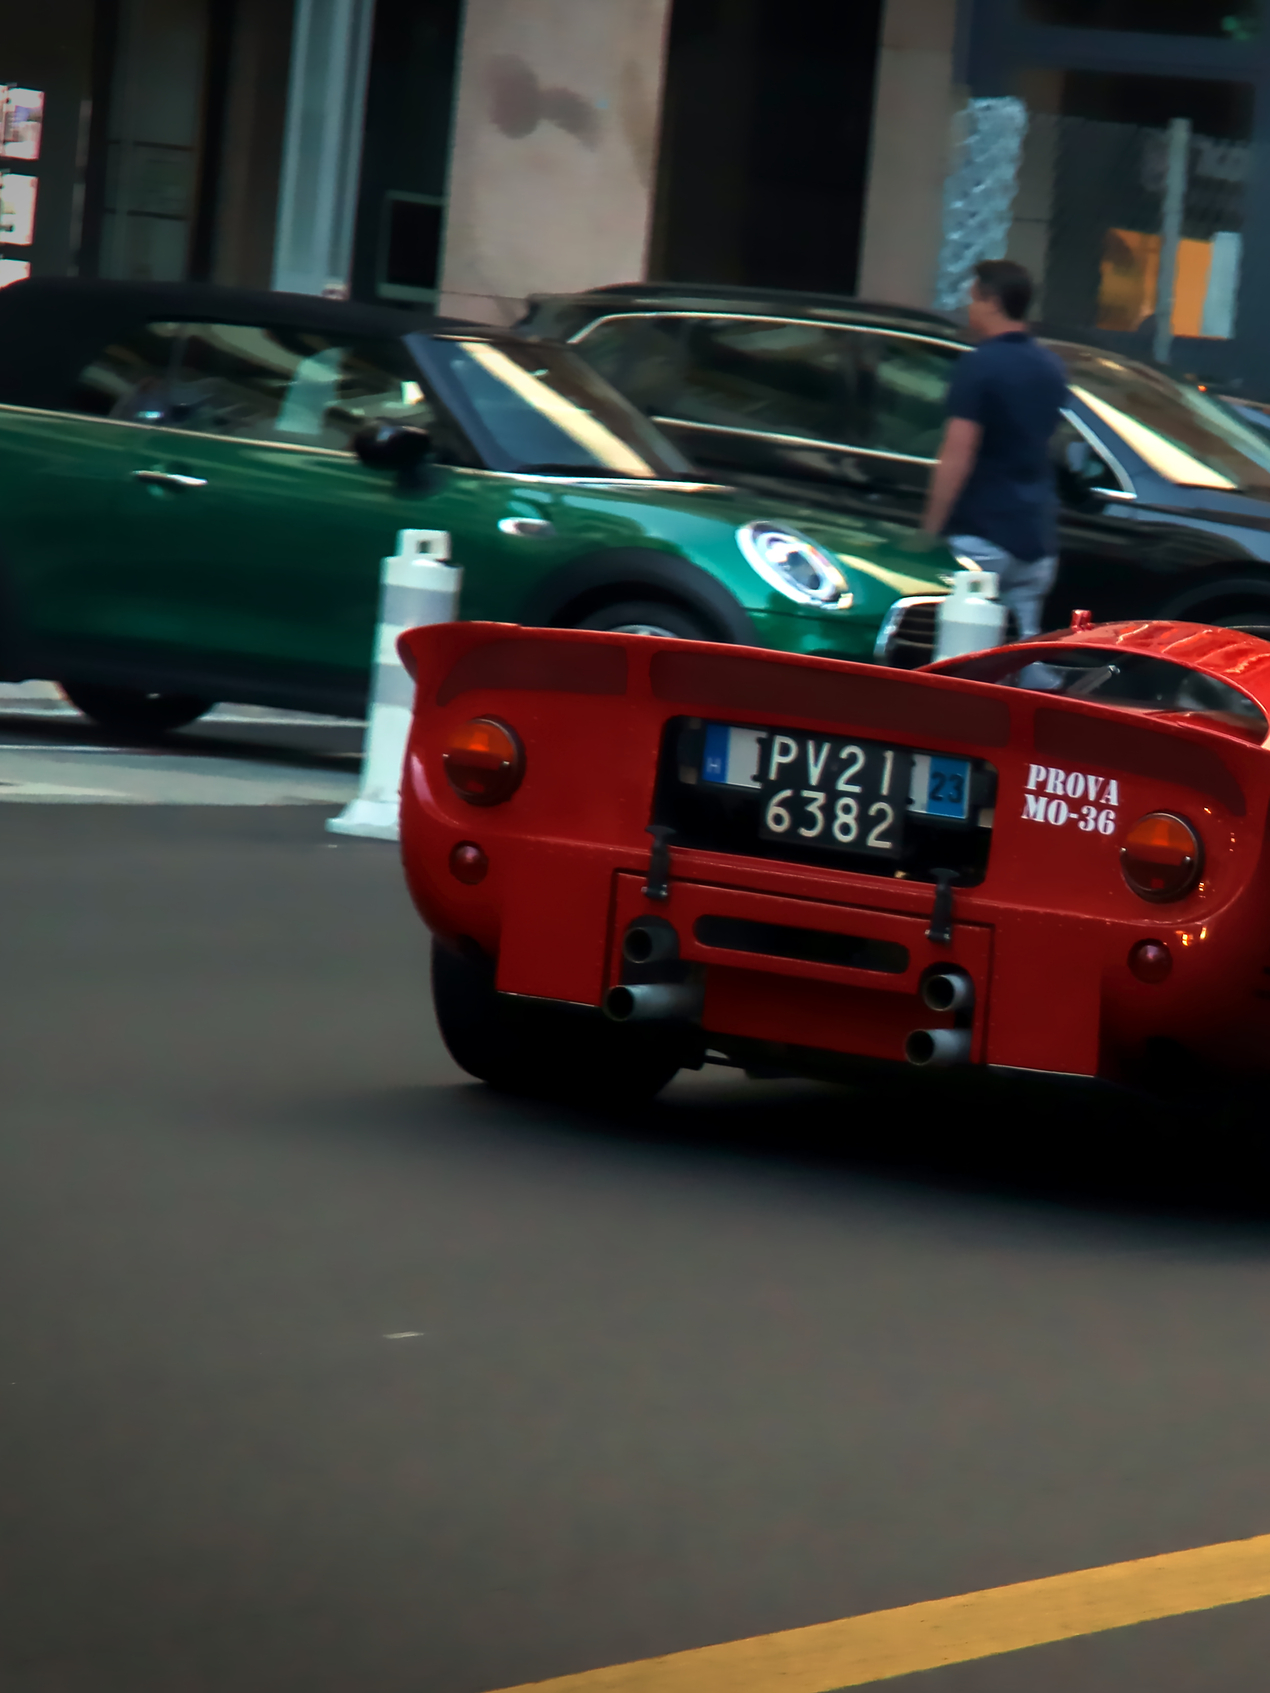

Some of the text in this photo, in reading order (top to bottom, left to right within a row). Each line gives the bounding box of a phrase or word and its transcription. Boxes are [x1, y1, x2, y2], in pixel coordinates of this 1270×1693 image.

[769, 734, 894, 796] PV21
[1024, 763, 1118, 806] PROVA
[929, 771, 965, 804] 23
[766, 789, 895, 849] 6382
[1021, 793, 1116, 835] MO-36
